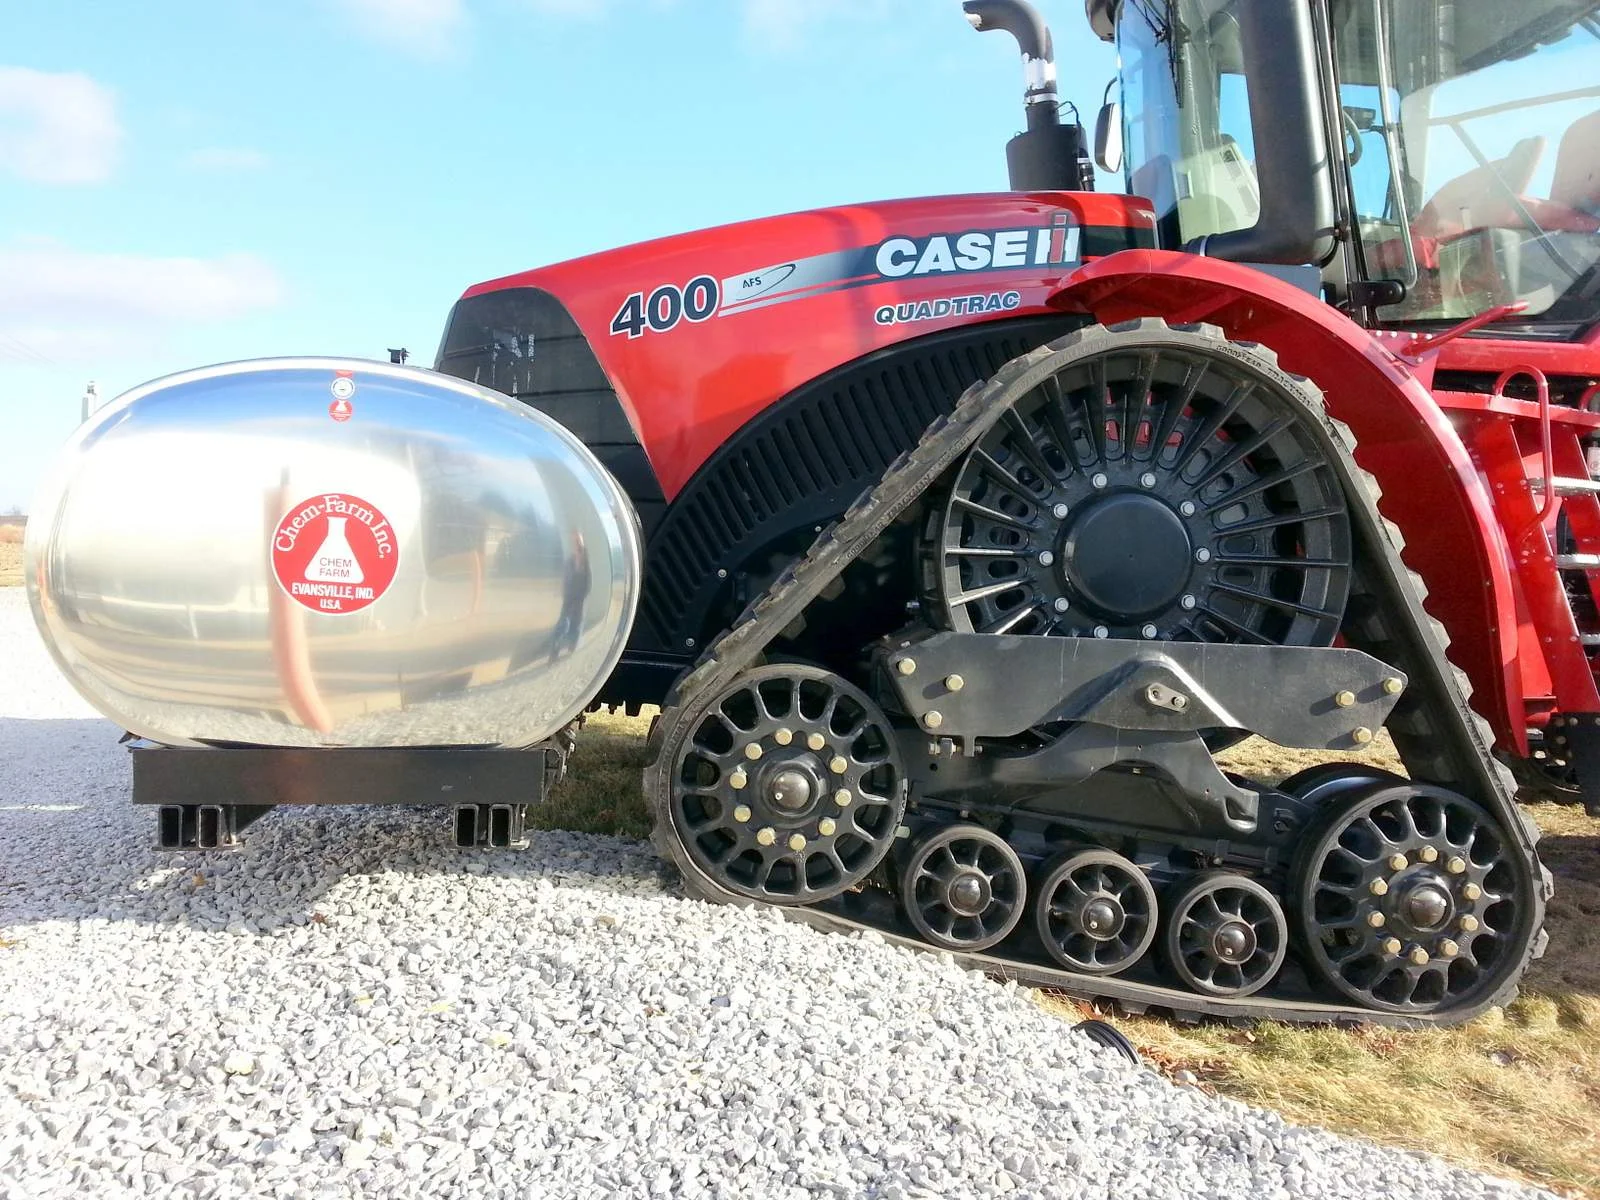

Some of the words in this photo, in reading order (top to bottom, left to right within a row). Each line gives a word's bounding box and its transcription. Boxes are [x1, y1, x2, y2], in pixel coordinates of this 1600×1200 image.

[875, 231, 1028, 278] CASE
[742, 276, 762, 289] AFS
[609, 274, 721, 340] 400
[875, 290, 1021, 326] QUADTRAC
[275, 495, 375, 552] Chem-Farm
[370, 518, 392, 559] Inc.
[319, 557, 352, 568] CHEM
[319, 567, 350, 578] FARM
[291, 582, 354, 600] EVANSVILLE,
